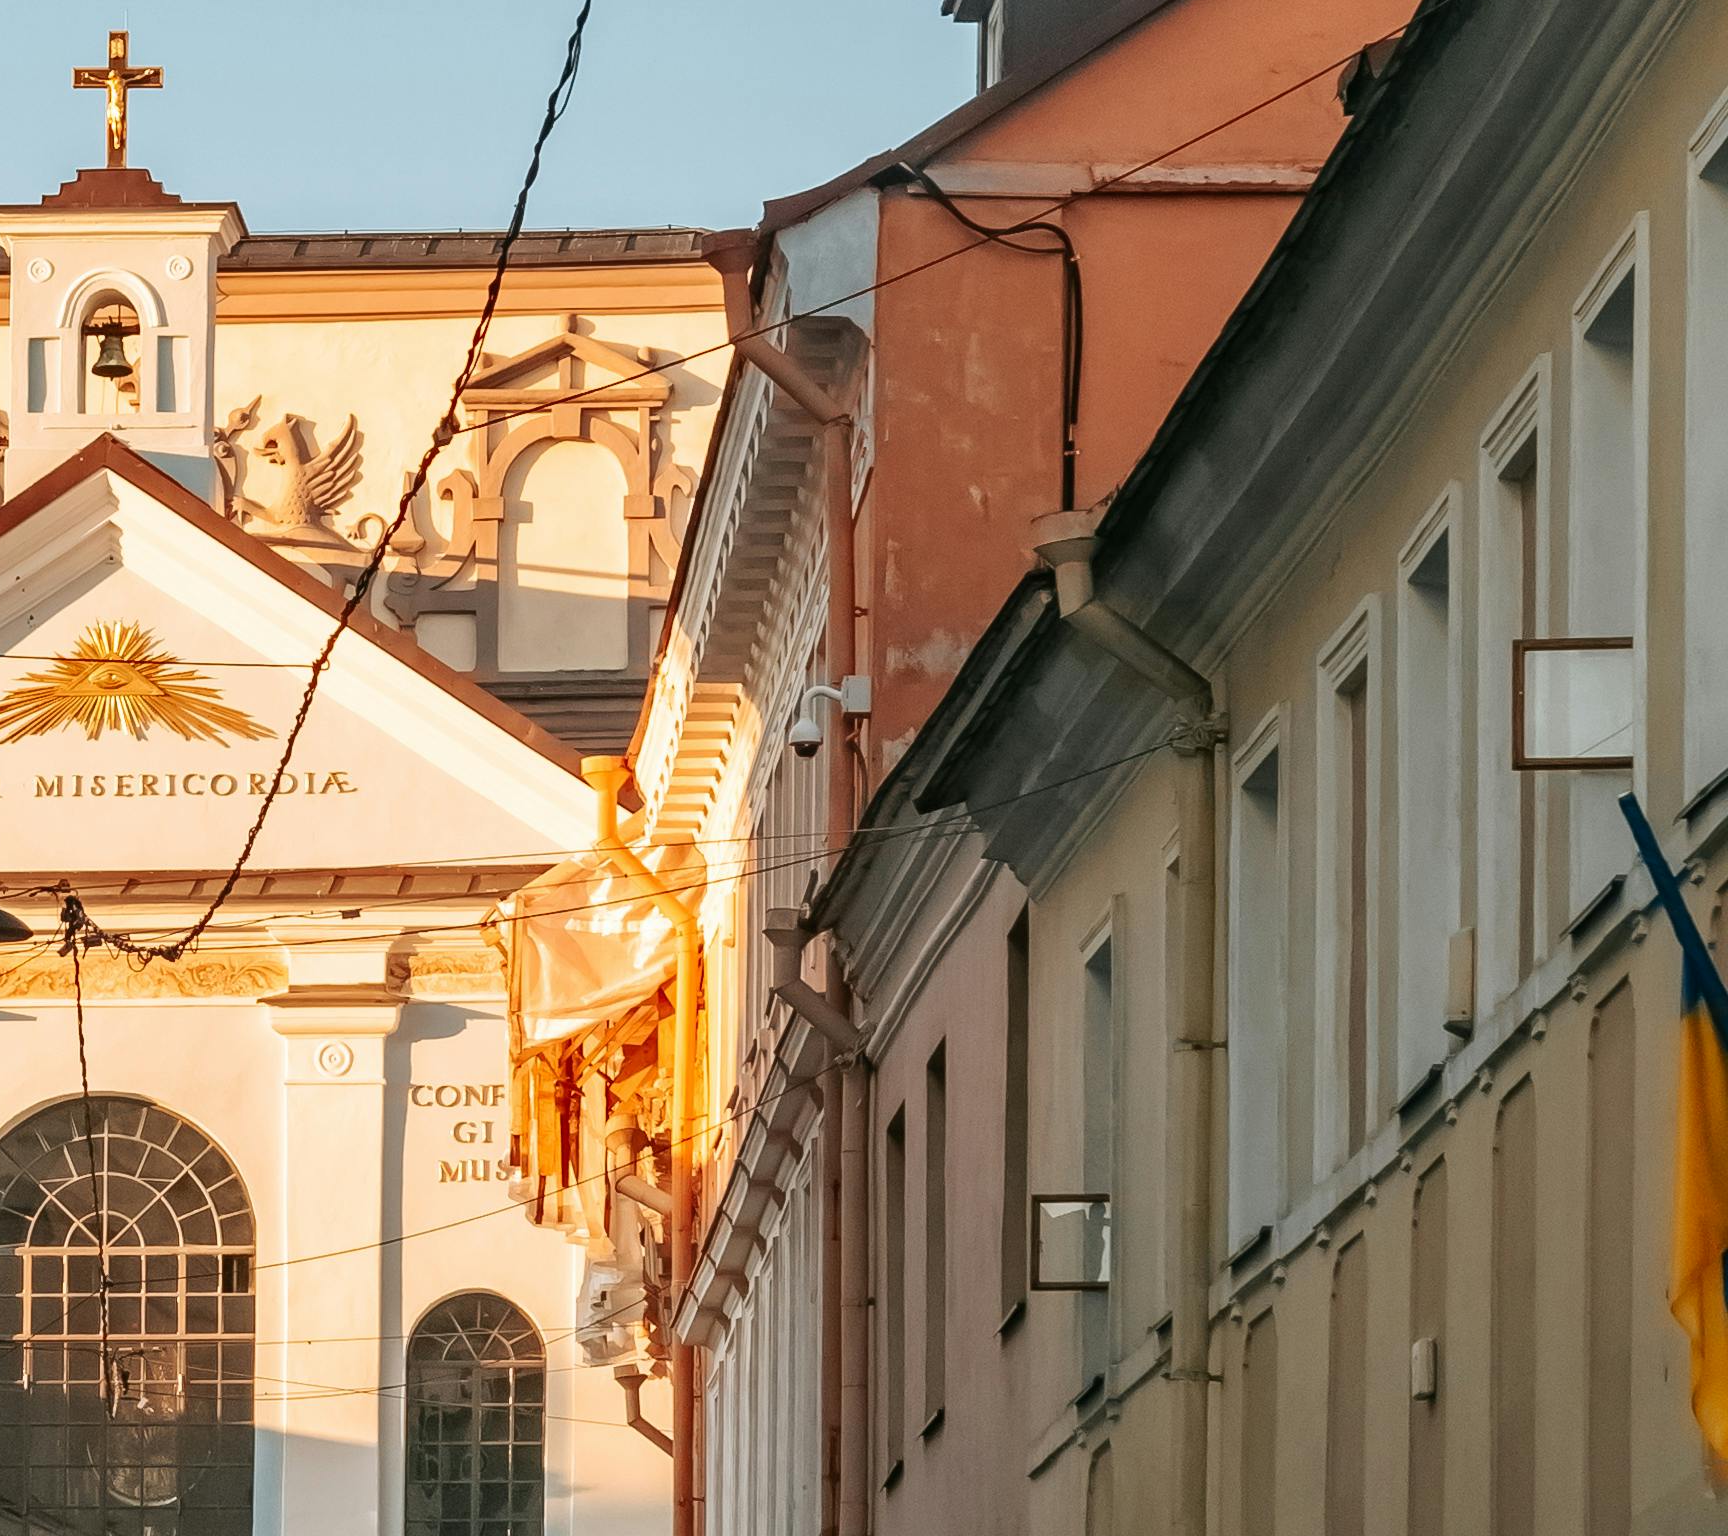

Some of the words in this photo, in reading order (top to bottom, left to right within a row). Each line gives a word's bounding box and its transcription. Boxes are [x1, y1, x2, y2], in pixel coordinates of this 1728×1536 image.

[34, 771, 358, 798] MISERICORDIÆ
[452, 1120, 494, 1144] GI
[438, 1159, 514, 1183] MUS
